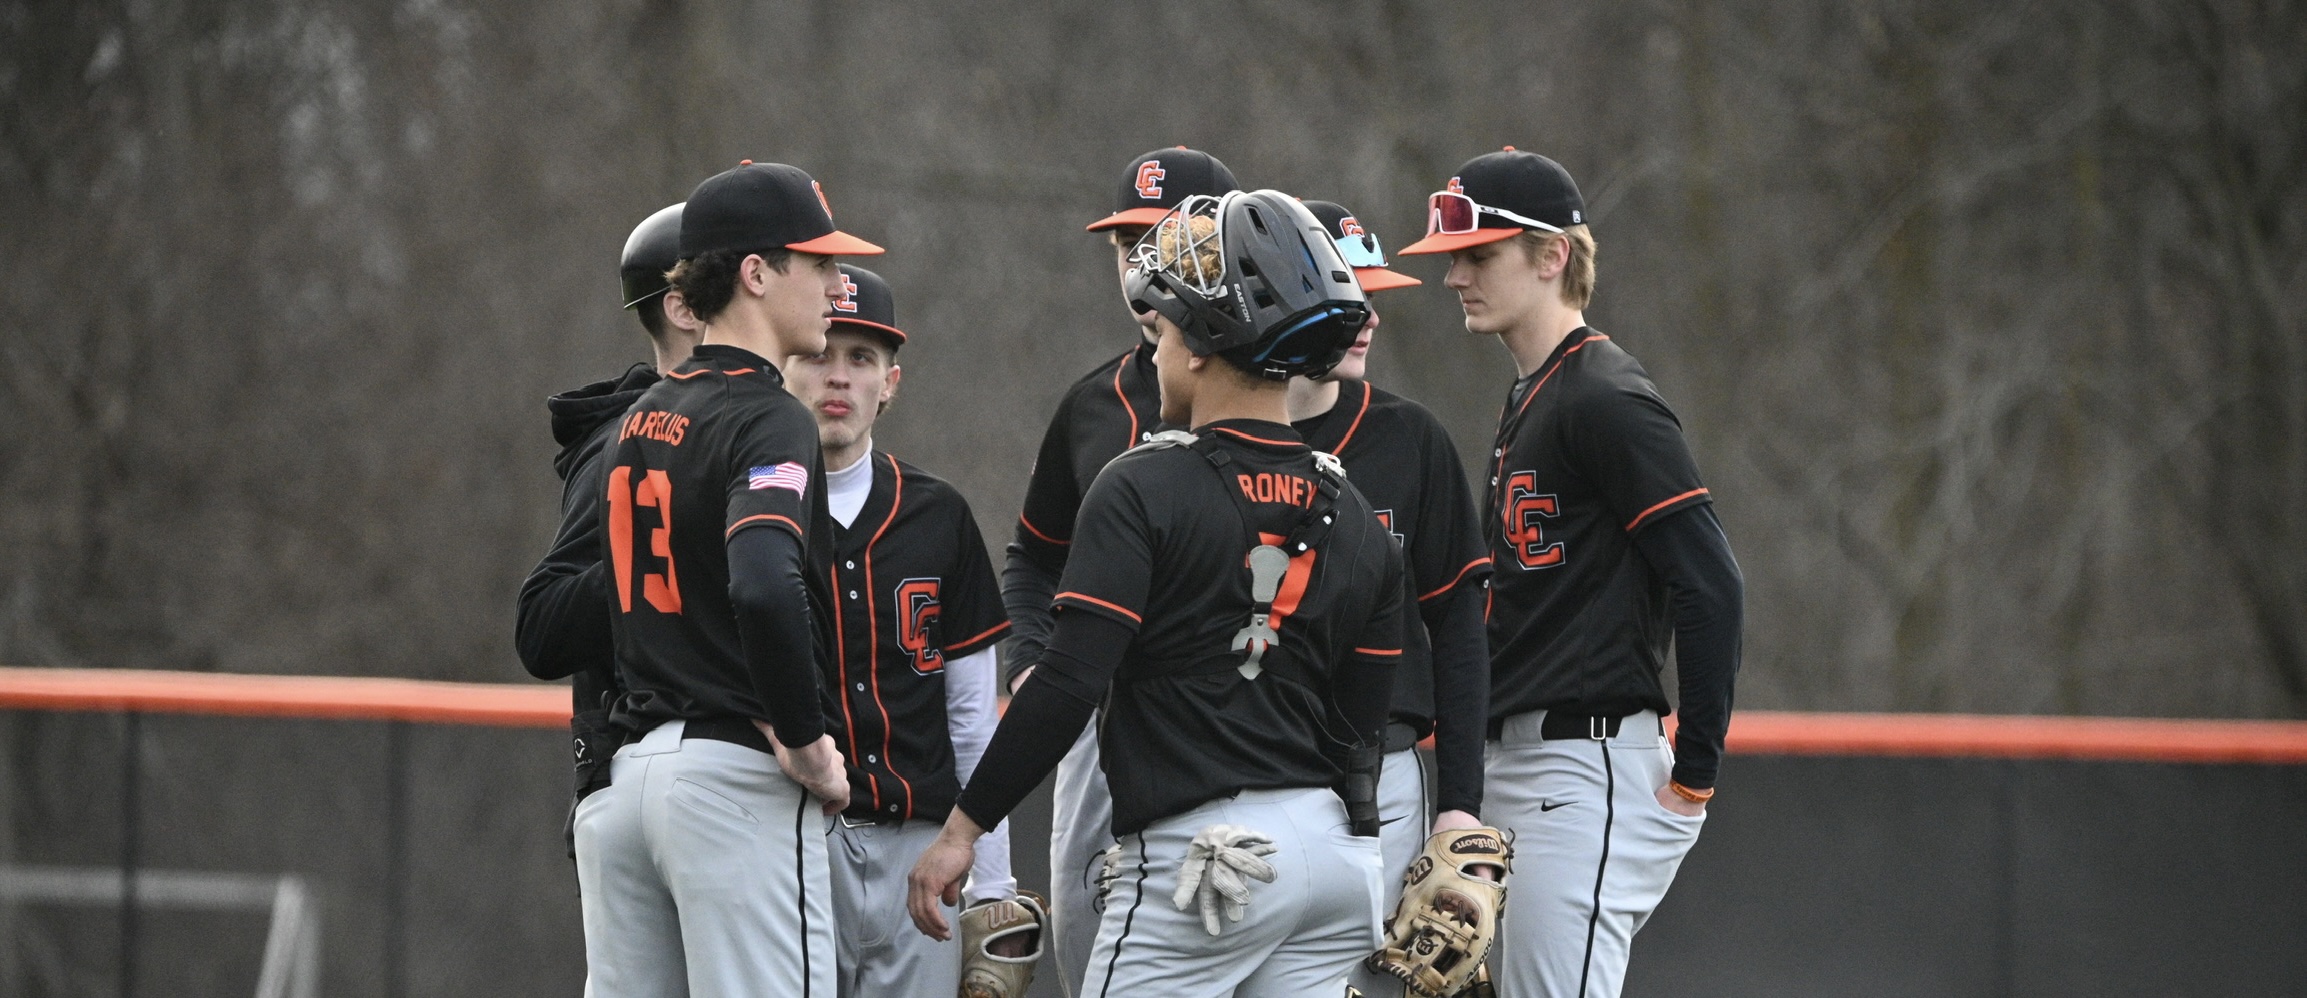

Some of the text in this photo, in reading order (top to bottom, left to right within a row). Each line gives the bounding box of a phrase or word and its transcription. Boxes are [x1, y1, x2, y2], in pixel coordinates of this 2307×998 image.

[1233, 283, 1252, 323] EASTON
[1237, 473, 1318, 510] RONEY
[607, 466, 682, 615] 13
[1455, 837, 1499, 851] Wilson
